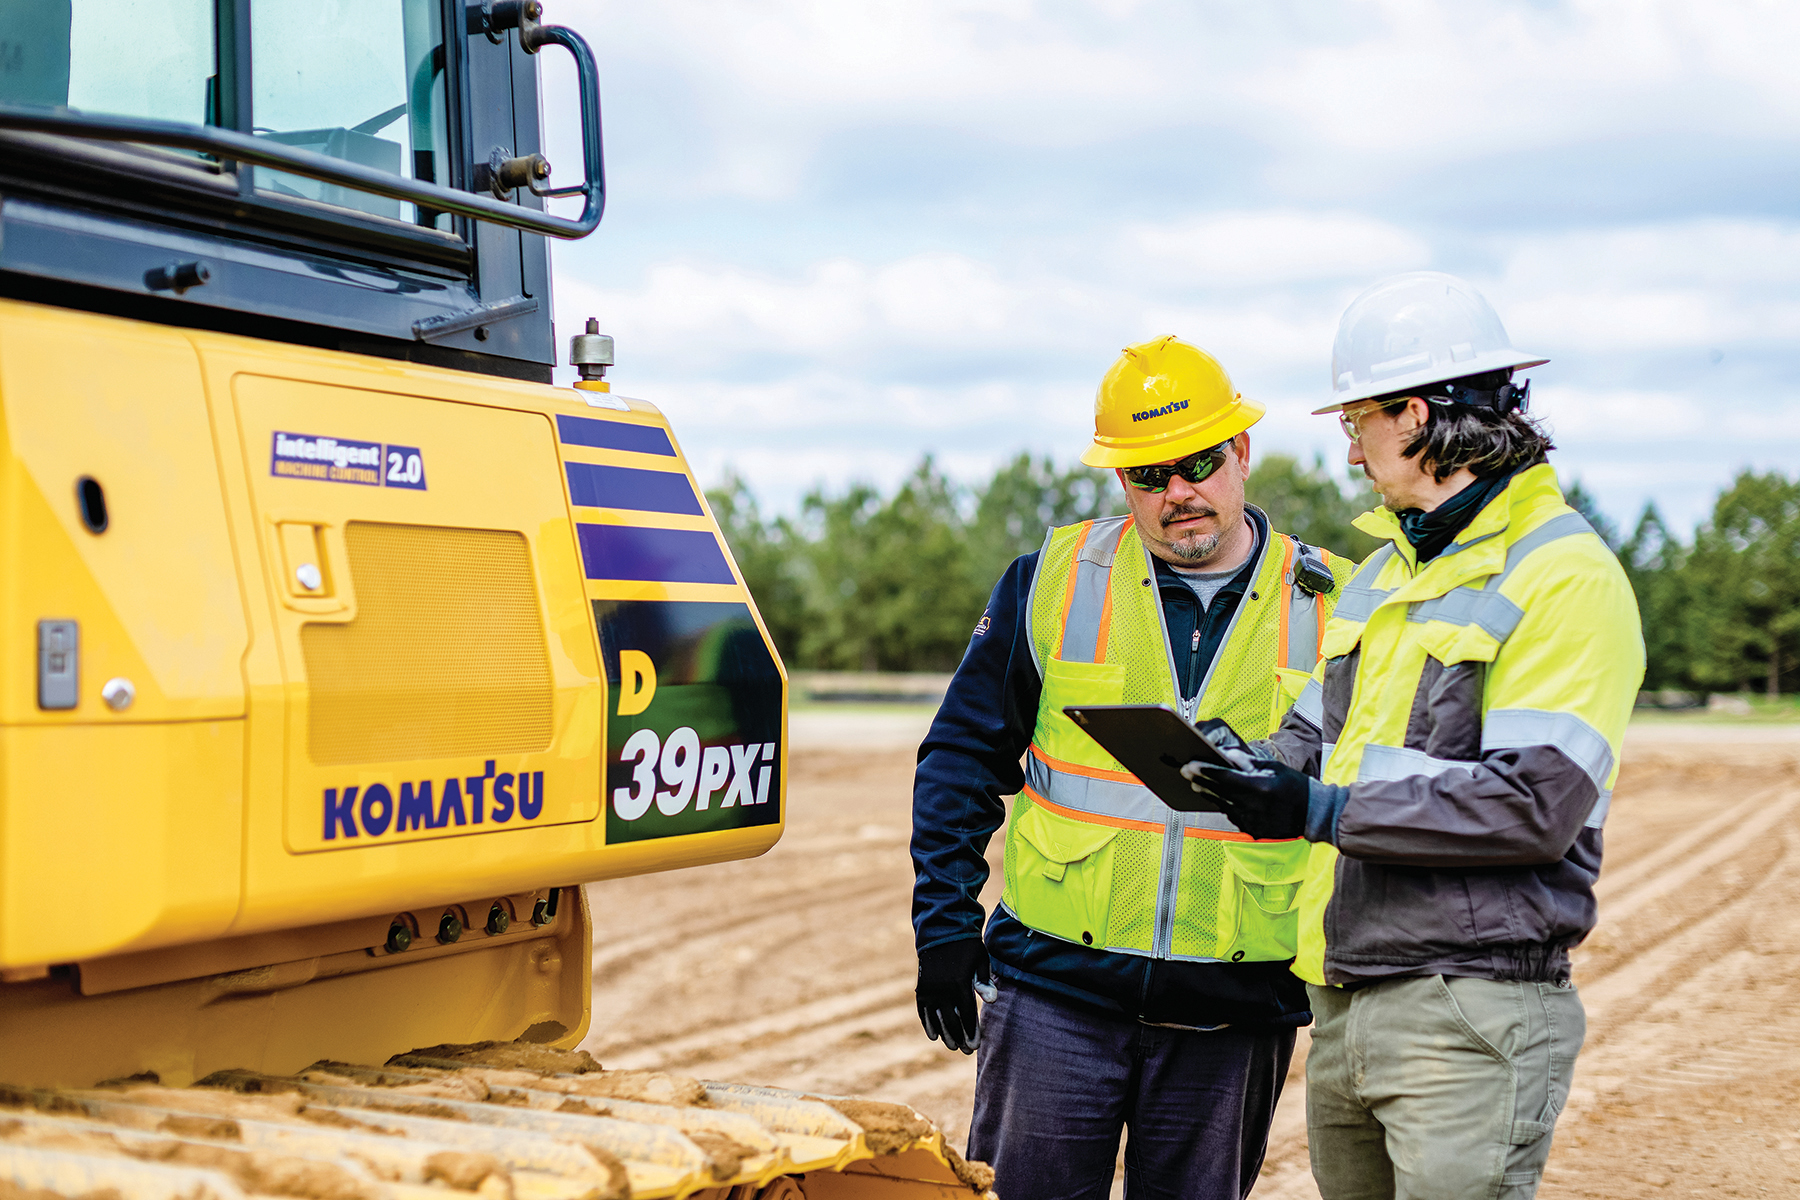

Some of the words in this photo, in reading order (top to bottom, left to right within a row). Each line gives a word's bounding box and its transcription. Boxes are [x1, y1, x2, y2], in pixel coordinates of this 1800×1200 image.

[1132, 399, 1189, 422] KOMATSU
[275, 433, 380, 468] intelligent
[387, 452, 422, 483] 2.0
[617, 650, 657, 716] D
[613, 726, 776, 821] 39PXi
[323, 759, 544, 841] KOMATSU
